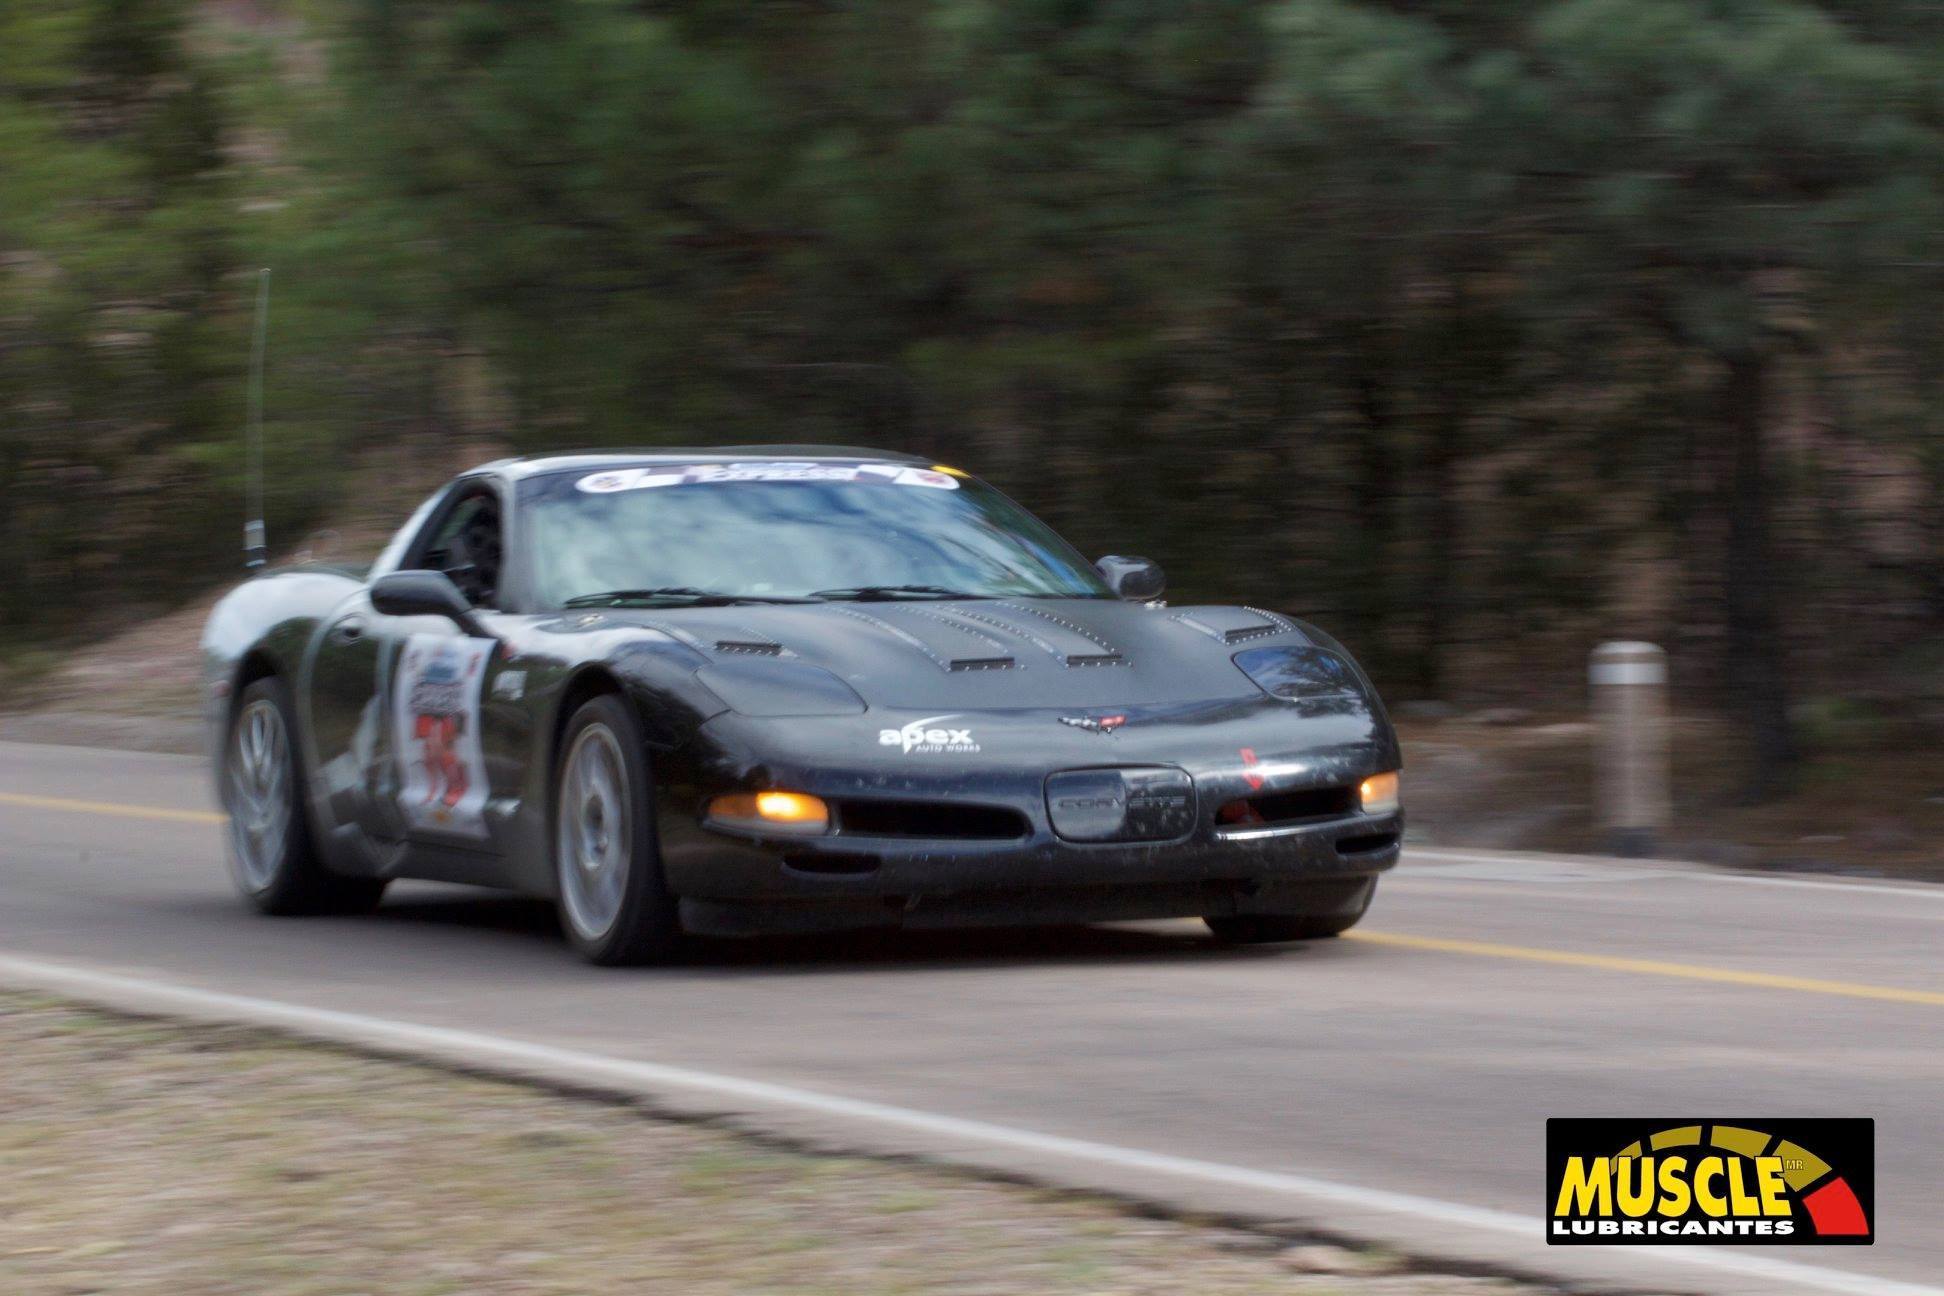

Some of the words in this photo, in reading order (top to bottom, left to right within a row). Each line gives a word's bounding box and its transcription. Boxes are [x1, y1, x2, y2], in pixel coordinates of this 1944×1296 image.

[879, 714, 974, 754] apex
[915, 743, 943, 753] AUTO
[946, 743, 981, 753] WORKS
